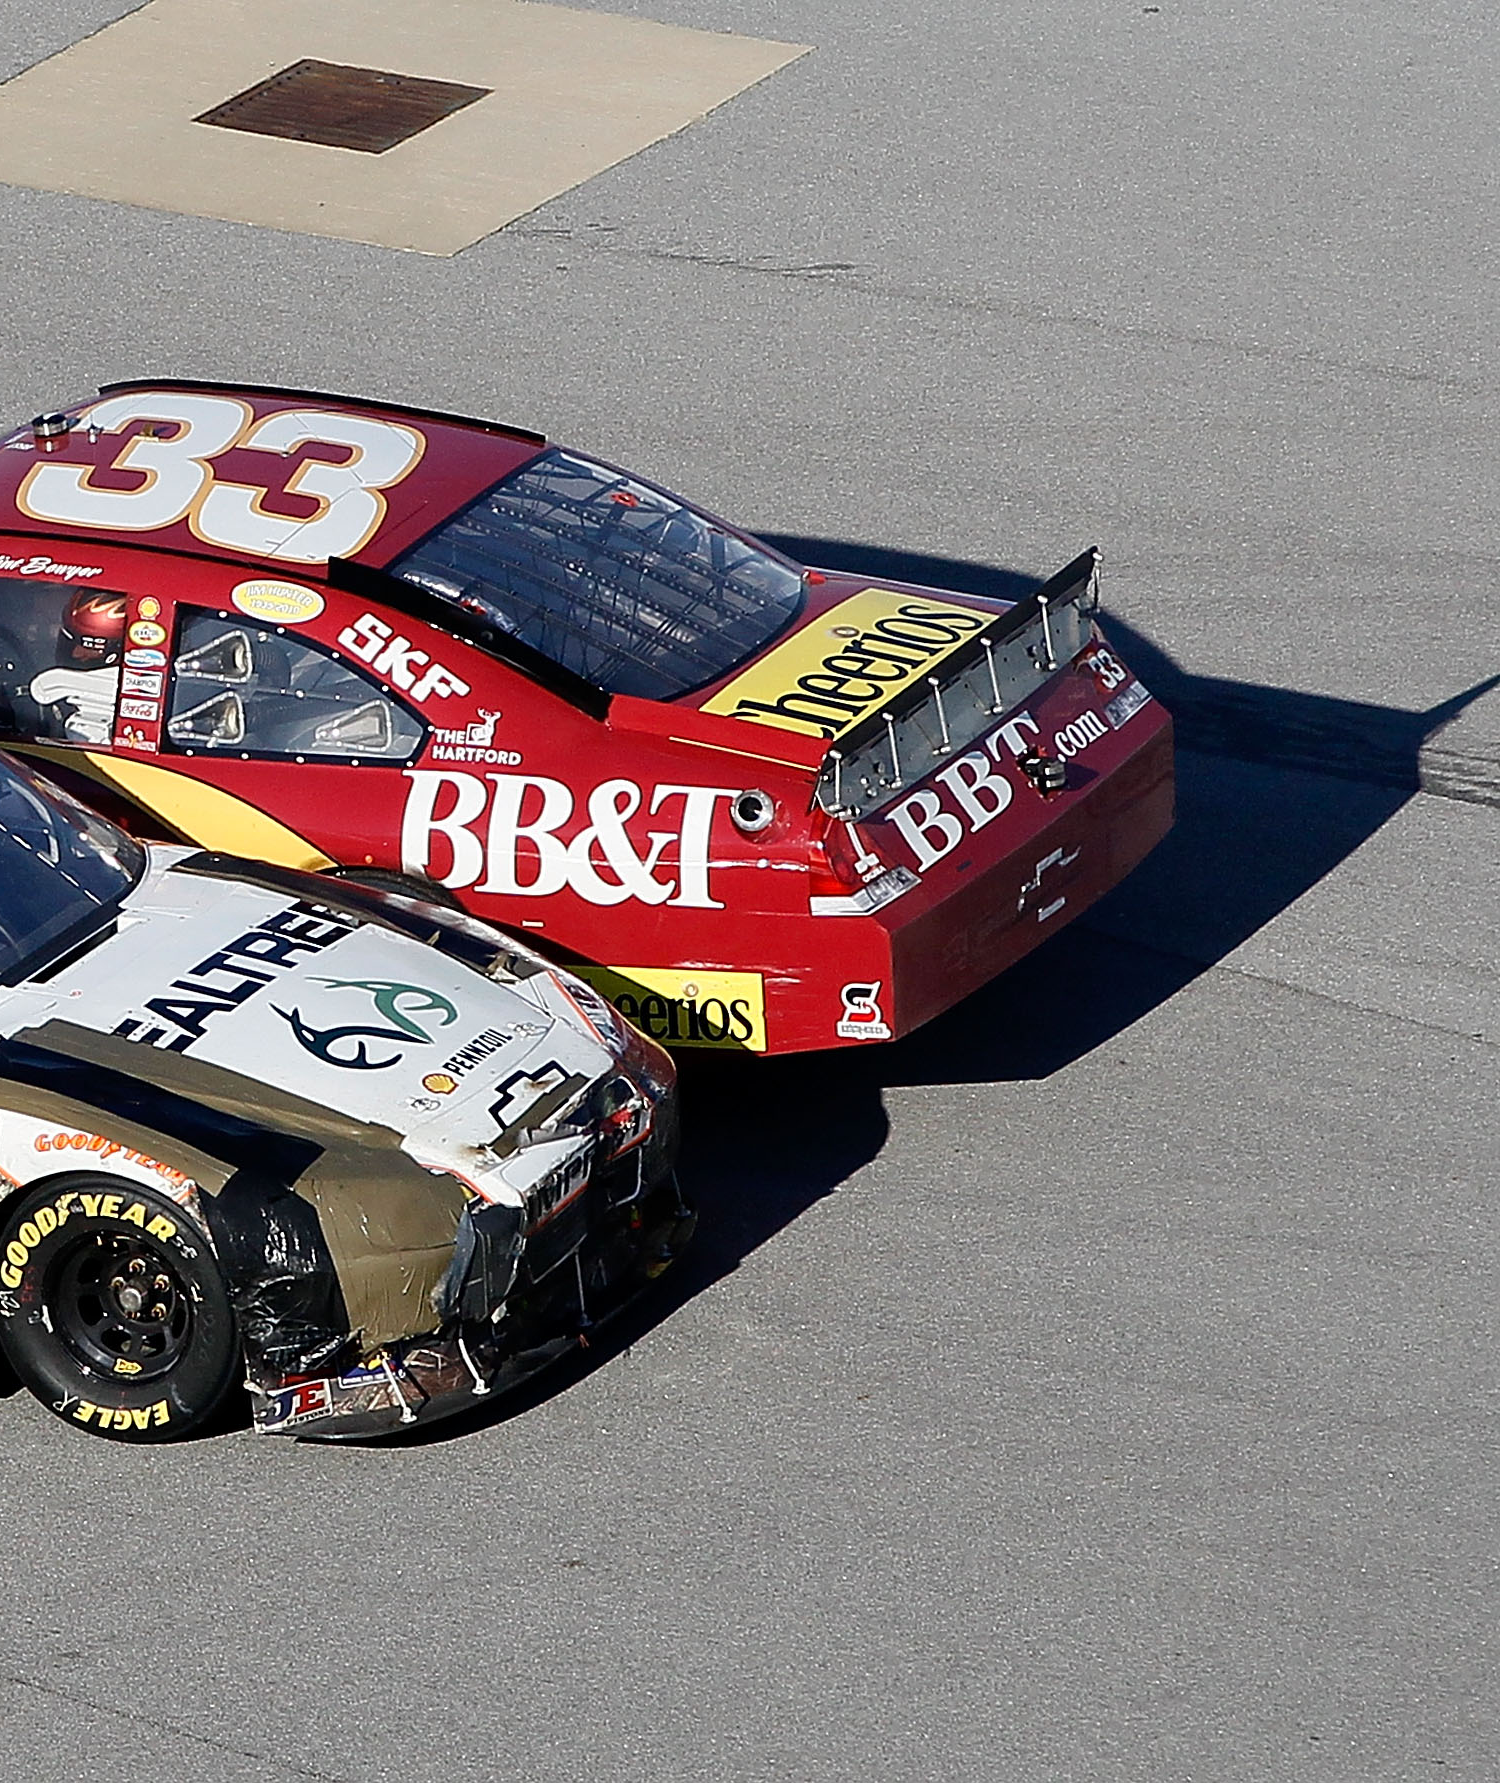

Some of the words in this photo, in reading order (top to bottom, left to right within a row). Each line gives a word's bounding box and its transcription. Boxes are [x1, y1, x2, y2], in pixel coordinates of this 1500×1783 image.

[17, 392, 426, 562] 33
[20, 557, 102, 581] Bowyer
[337, 613, 471, 703] SKF
[1088, 648, 1127, 689] 33
[431, 746, 522, 766] HARTFORD
[435, 727, 465, 744] THE
[402, 769, 744, 910] BB&T
[442, 1028, 513, 1078] PENNZOIL
[0, 1191, 177, 1289] GOODYEAR
[73, 1399, 171, 1431] EAGLE
